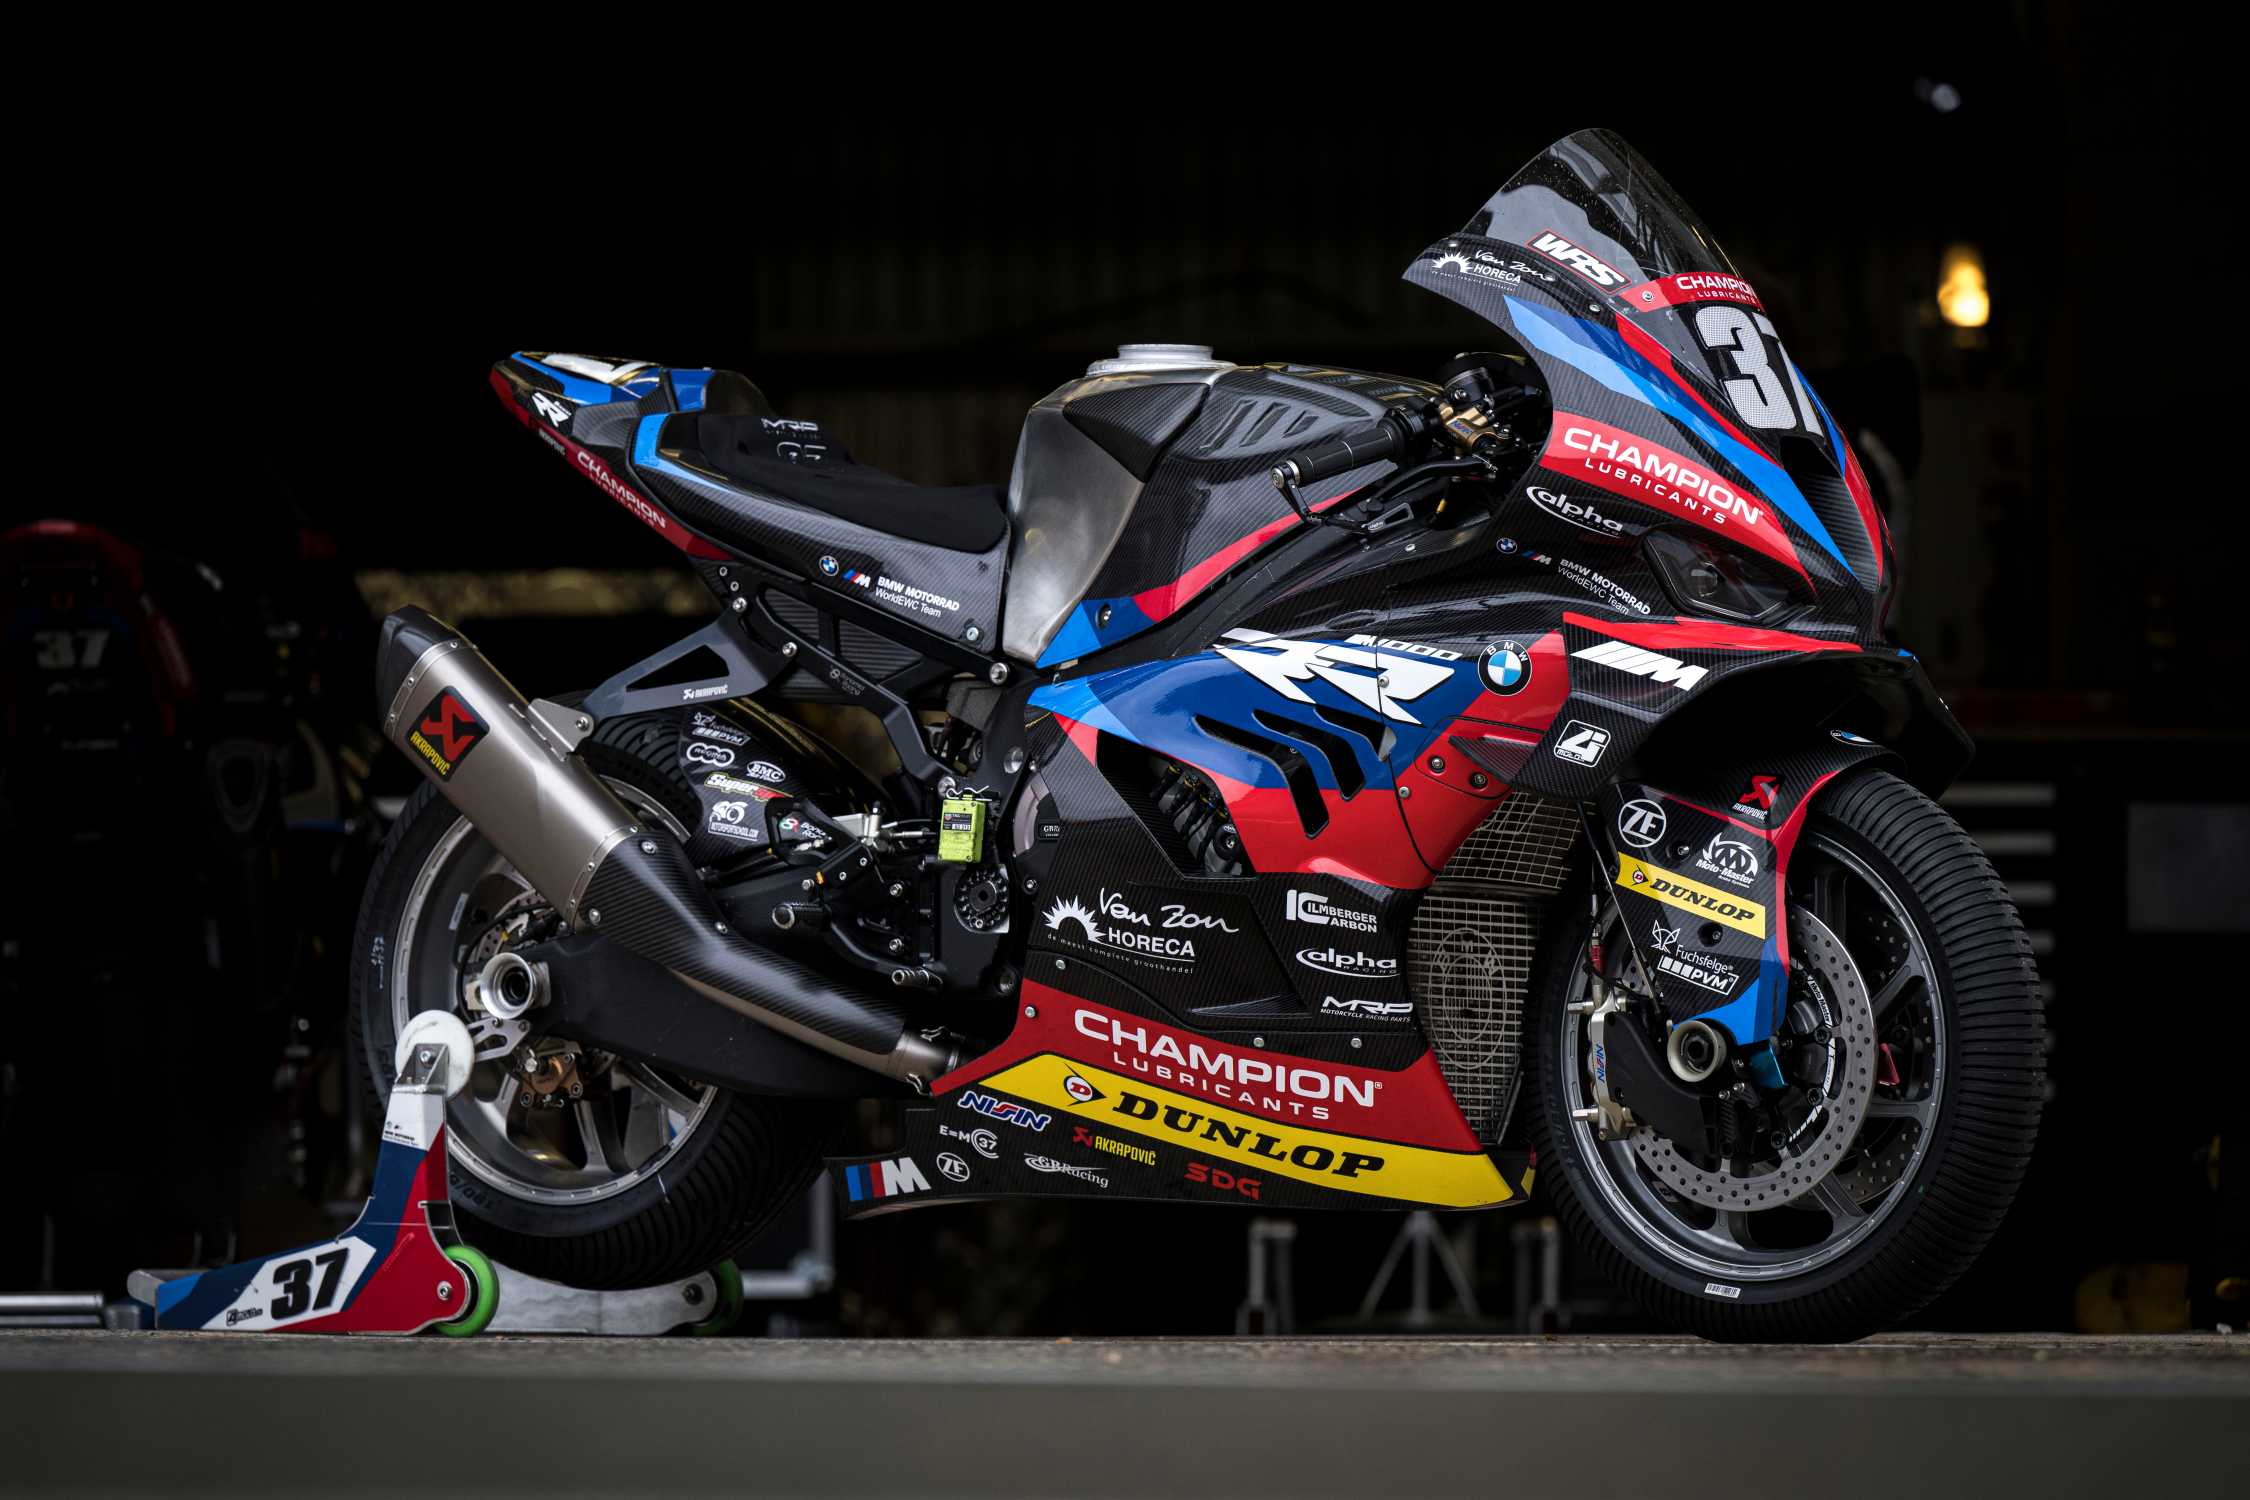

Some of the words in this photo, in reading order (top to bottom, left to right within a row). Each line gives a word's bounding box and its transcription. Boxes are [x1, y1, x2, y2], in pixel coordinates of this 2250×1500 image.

[1474, 264, 1521, 285] HORECA
[1475, 249, 1504, 266] Van
[1510, 260, 1550, 282] Zon
[1532, 233, 1625, 286] WRS
[1695, 306, 1825, 438] 37
[577, 451, 666, 528] CHAMPION
[1564, 427, 1760, 525] CHAMPION
[1586, 458, 1726, 524] LUBRICANTS
[1537, 491, 1623, 532] alpha
[875, 587, 919, 610] WorldEWC
[920, 602, 941, 618] Team
[877, 576, 904, 593] BMW
[905, 586, 960, 611] MOTORRAD
[1558, 566, 1606, 598] WorldEWC
[1608, 594, 1629, 616] Team
[1560, 559, 1591, 576] BMW
[1592, 572, 1651, 615] MOTORRAD
[751, 763, 781, 780] BMC
[1621, 803, 1665, 843] ZF
[1100, 888, 1151, 926] Van
[1161, 905, 1240, 933] Zon
[1650, 878, 1755, 921] DUNLOP
[1089, 946, 1130, 962] complete
[1134, 959, 1194, 974] groothandel
[1108, 927, 1195, 957] HORECA
[1307, 948, 1397, 968] alpha
[1676, 944, 1728, 974] Fuchsfelge
[1690, 969, 1729, 990] PVM
[1320, 1008, 1363, 1019] MOTORCYCLE
[1074, 1009, 1375, 1107] CHAMPION
[1114, 1051, 1330, 1120] LUBRICANTS
[1113, 1091, 1385, 1178] DUNLOP
[940, 1155, 968, 1179] ZF
[1184, 1162, 1262, 1199] SDG
[271, 1247, 349, 1320] 37
